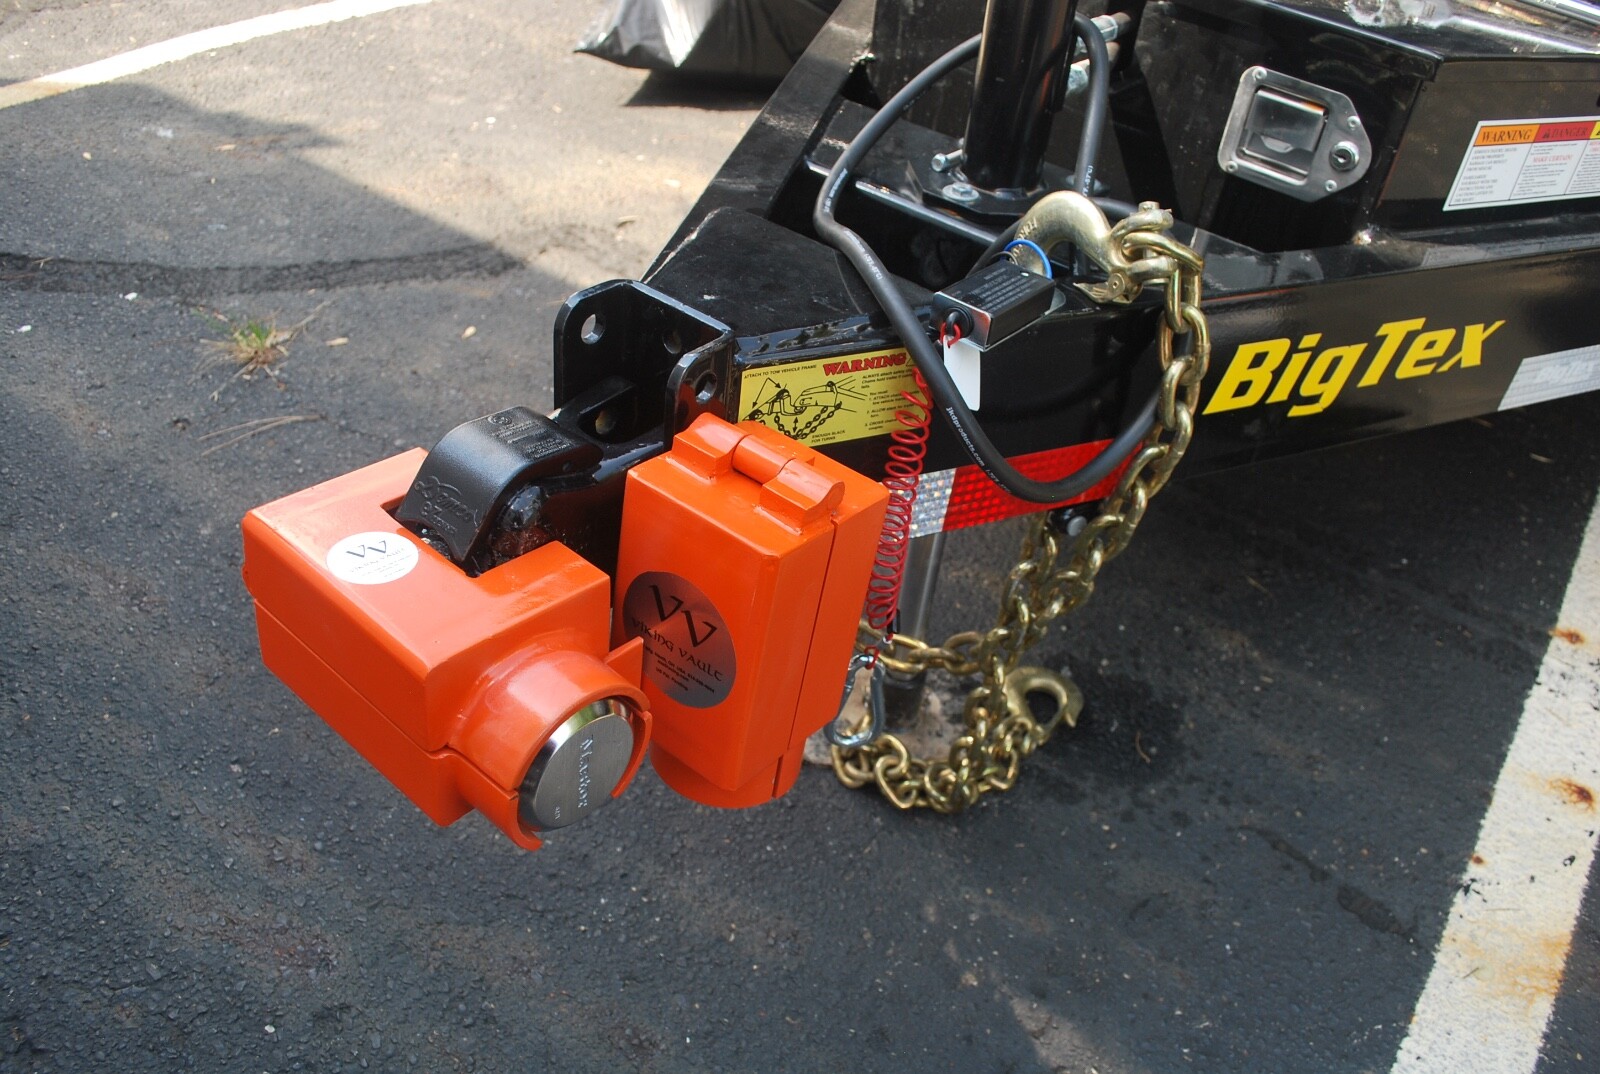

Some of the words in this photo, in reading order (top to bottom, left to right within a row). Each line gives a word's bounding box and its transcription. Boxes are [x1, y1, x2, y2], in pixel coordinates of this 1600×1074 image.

[1482, 129, 1532, 143] WARNING
[1552, 127, 1588, 138] DANGER
[823, 353, 907, 376] WARNING
[946, 407, 985, 467] jkdproducts.com
